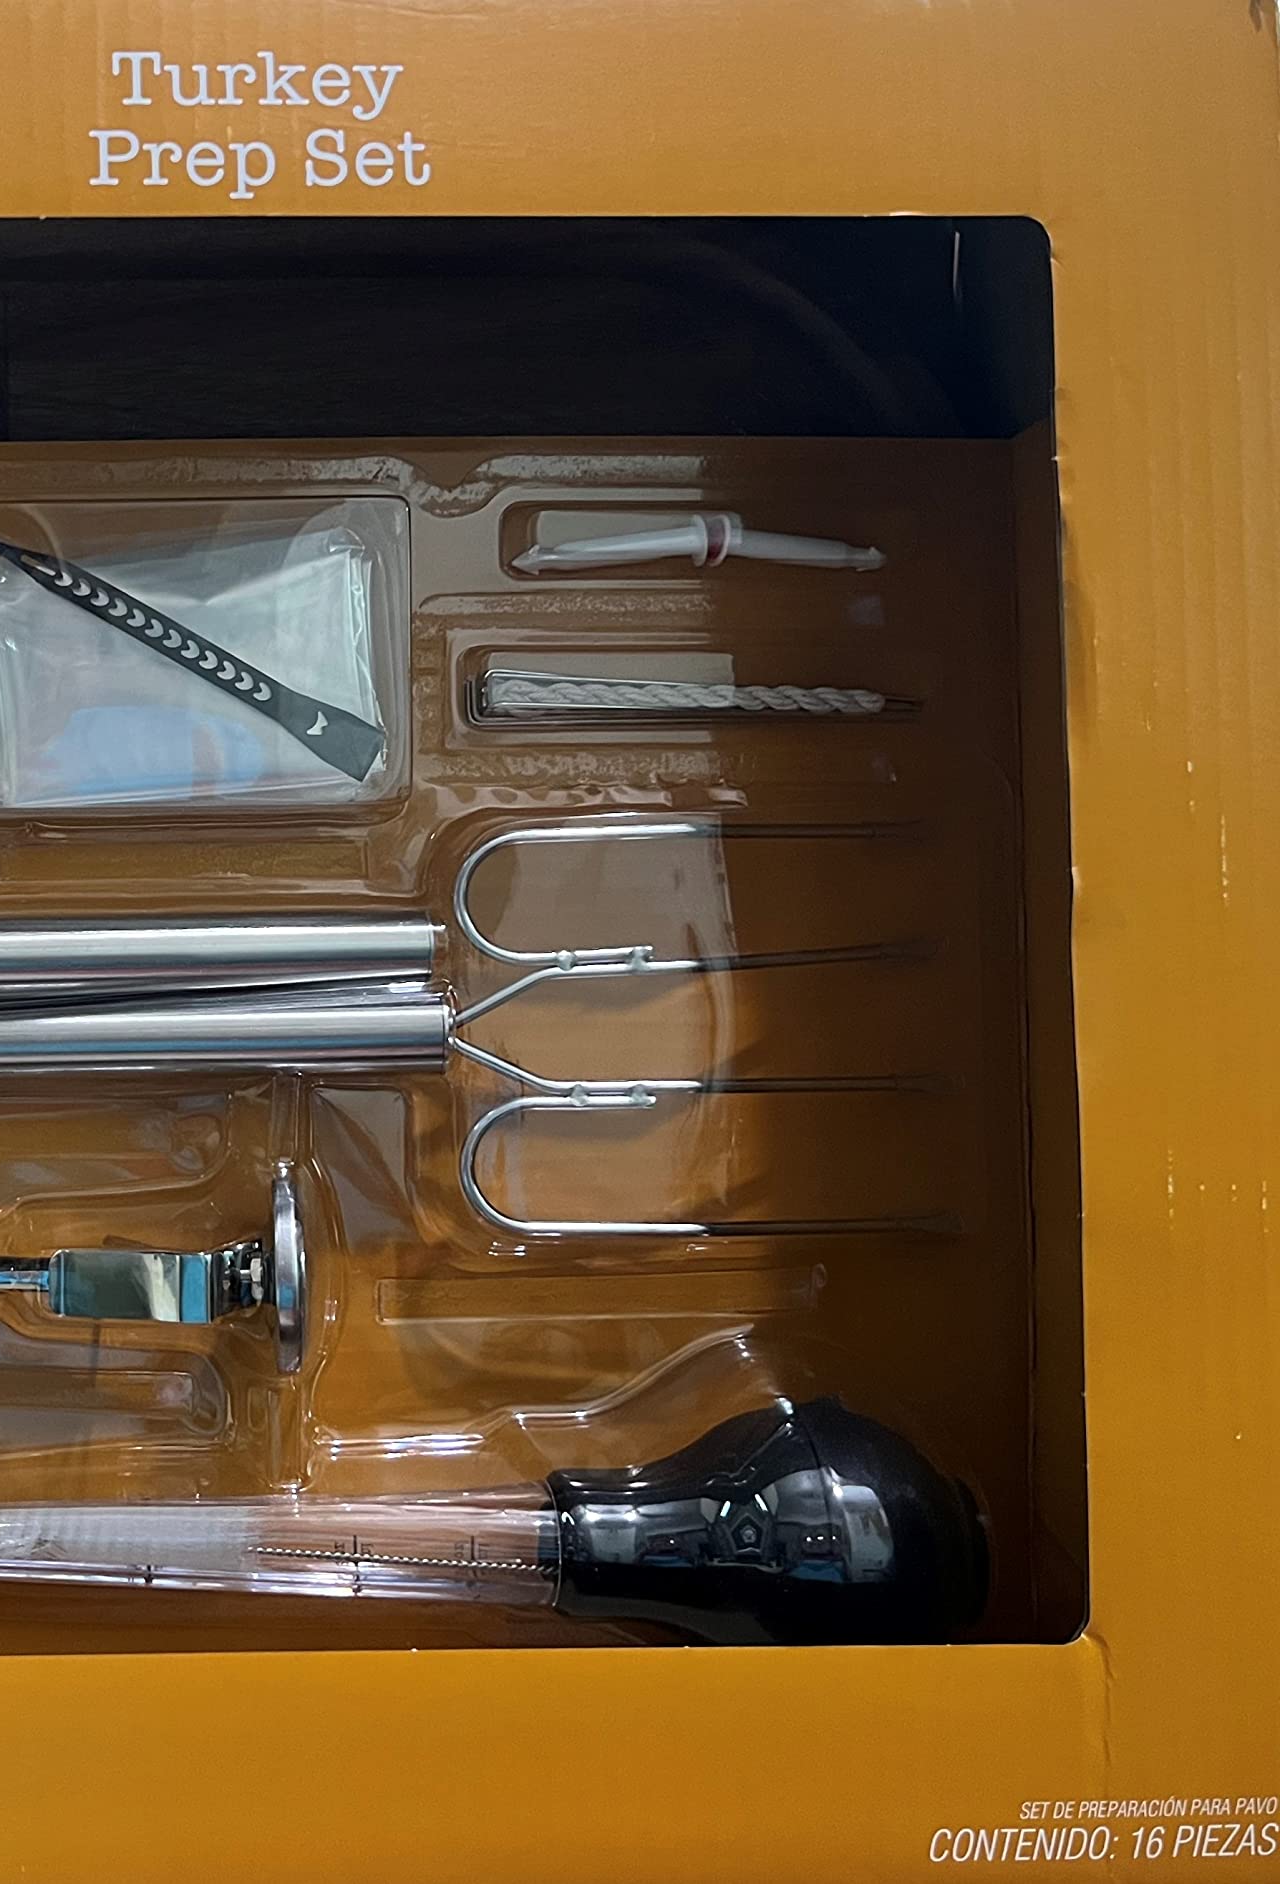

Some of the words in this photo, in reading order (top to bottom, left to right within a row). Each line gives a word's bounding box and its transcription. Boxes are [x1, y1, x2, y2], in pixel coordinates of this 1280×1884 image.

[111, 49, 405, 122] Turkey
[87, 128, 277, 200] Prep
[304, 127, 432, 188] Set
[1019, 1801, 1050, 1820] SET
[1054, 1801, 1074, 1819] DE
[1078, 1796, 1186, 1818] PREPARACIÓN
[1190, 1798, 1230, 1816] PARA
[1235, 1797, 1278, 1815] PAVO
[929, 1826, 1120, 1862] CONTENIDO:
[1131, 1826, 1166, 1860] 16
[1172, 1822, 1280, 1858] PIEZAS
